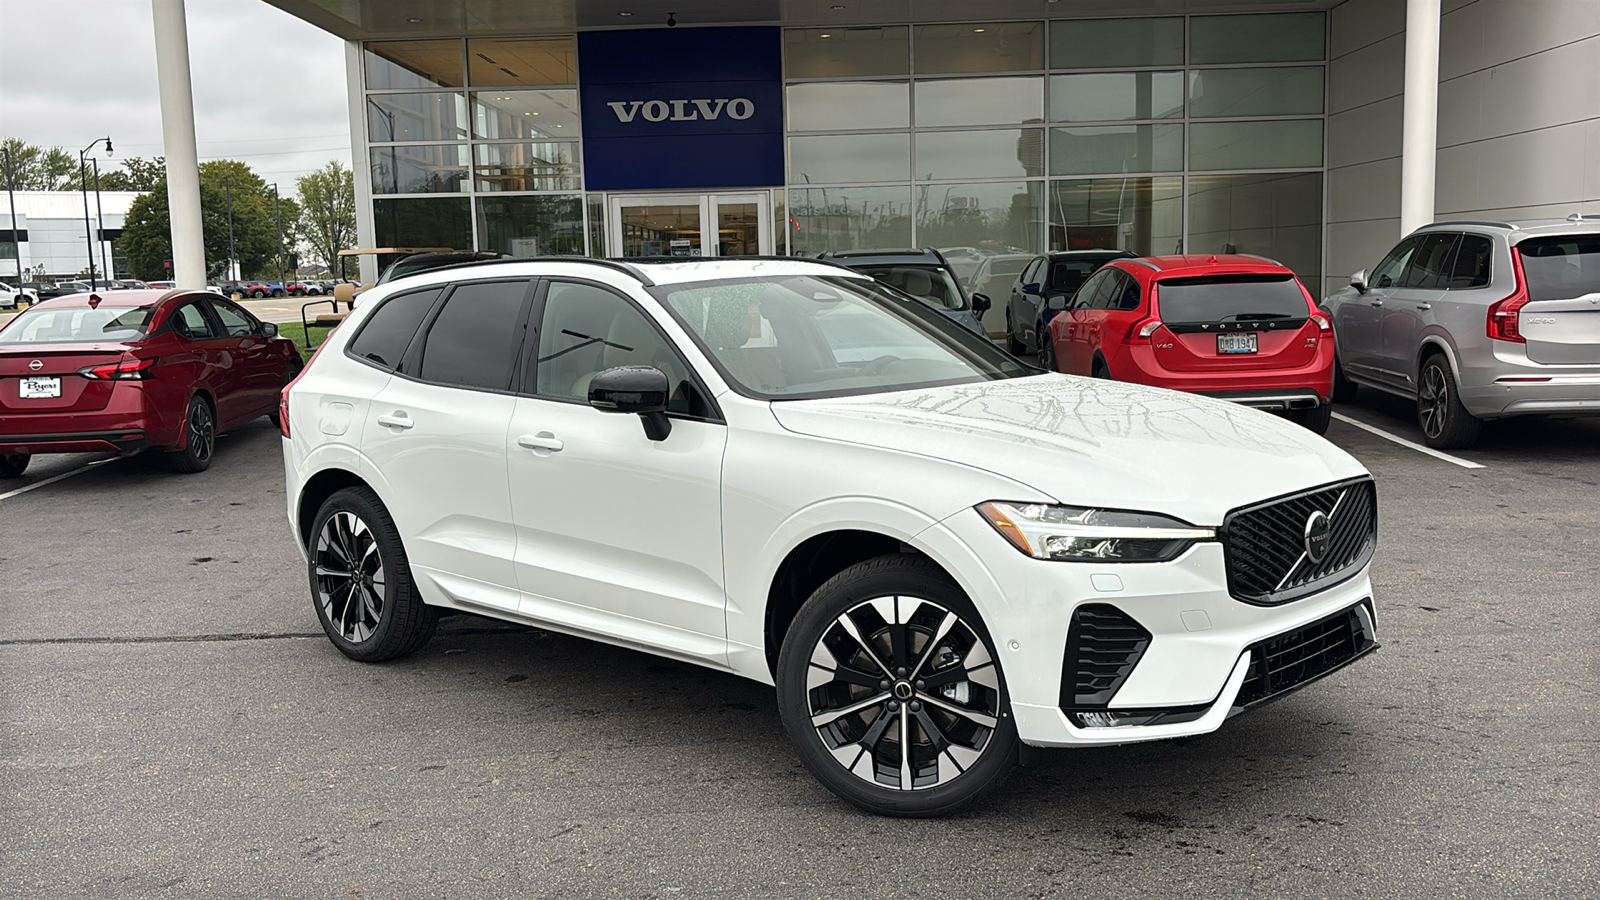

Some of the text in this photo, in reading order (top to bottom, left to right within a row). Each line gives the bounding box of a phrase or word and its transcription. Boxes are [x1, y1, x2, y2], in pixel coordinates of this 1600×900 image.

[607, 98, 754, 122] VOLVO
[1236, 337, 1255, 349] 1947
[23, 381, 57, 392] Byers
